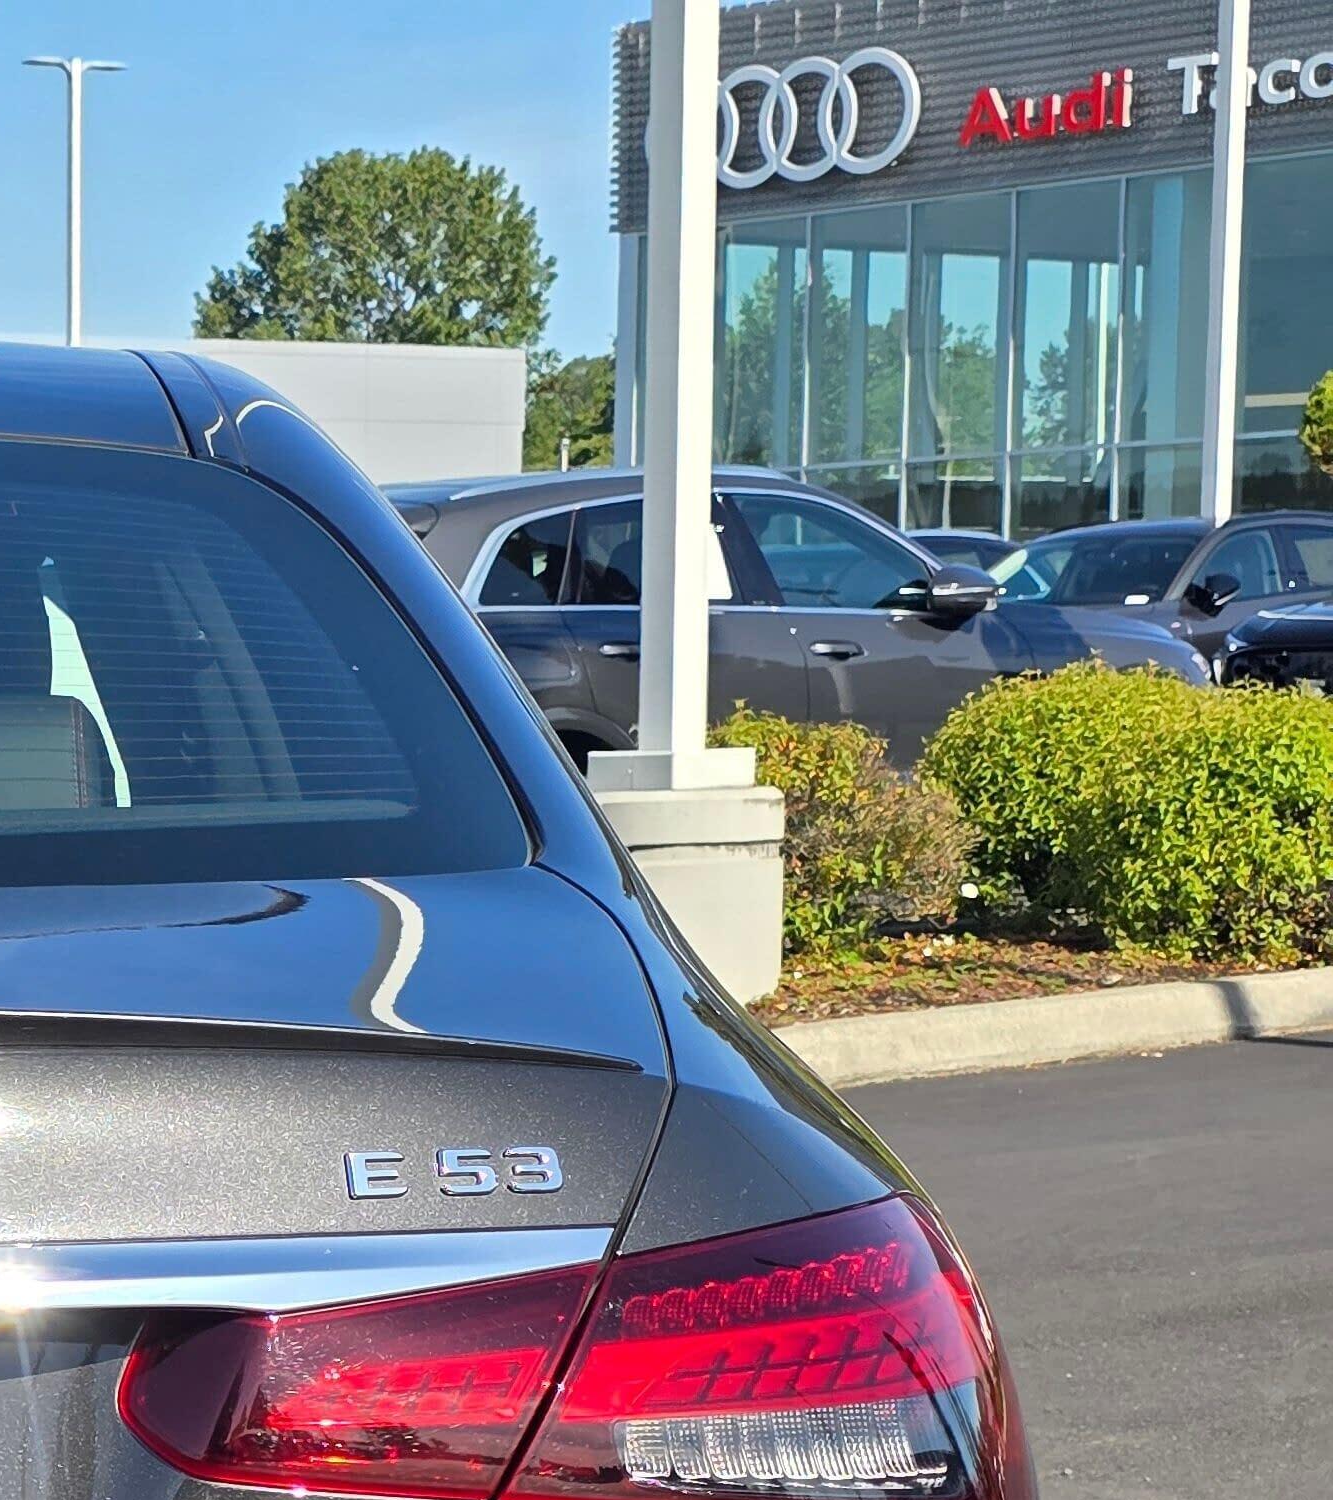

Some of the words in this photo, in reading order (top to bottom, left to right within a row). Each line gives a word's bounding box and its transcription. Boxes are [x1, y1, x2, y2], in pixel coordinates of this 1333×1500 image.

[955, 67, 1132, 148] Audi
[1167, 51, 1333, 114] Tco
[343, 1151, 409, 1200] E
[435, 1147, 564, 1197] 53
